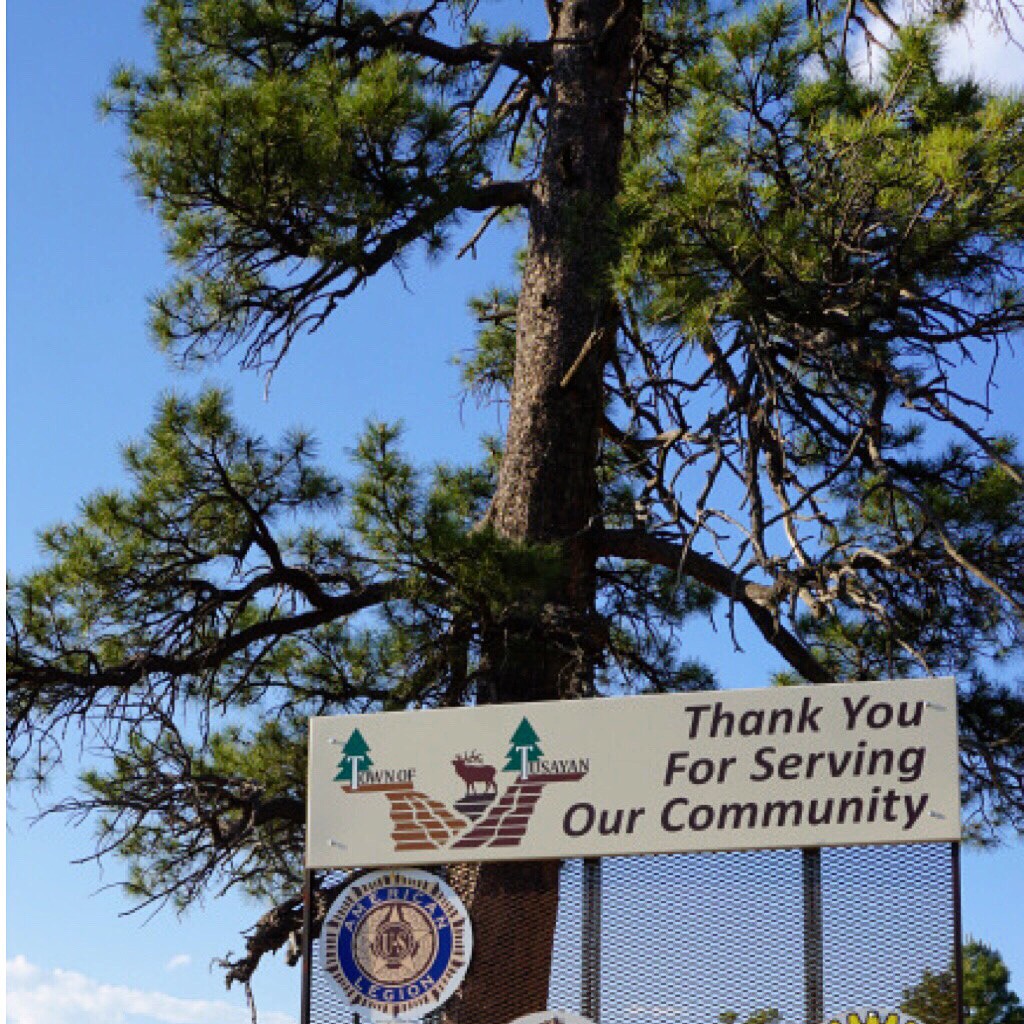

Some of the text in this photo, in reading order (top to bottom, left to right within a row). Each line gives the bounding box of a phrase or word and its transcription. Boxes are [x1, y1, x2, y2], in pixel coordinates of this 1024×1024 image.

[684, 696, 926, 739] Thank You
[396, 768, 416, 783] OF
[515, 745, 590, 780] TUSAYAN
[665, 745, 926, 786] For Serving
[563, 790, 928, 837] Our Community
[355, 975, 434, 1000] LEGION
